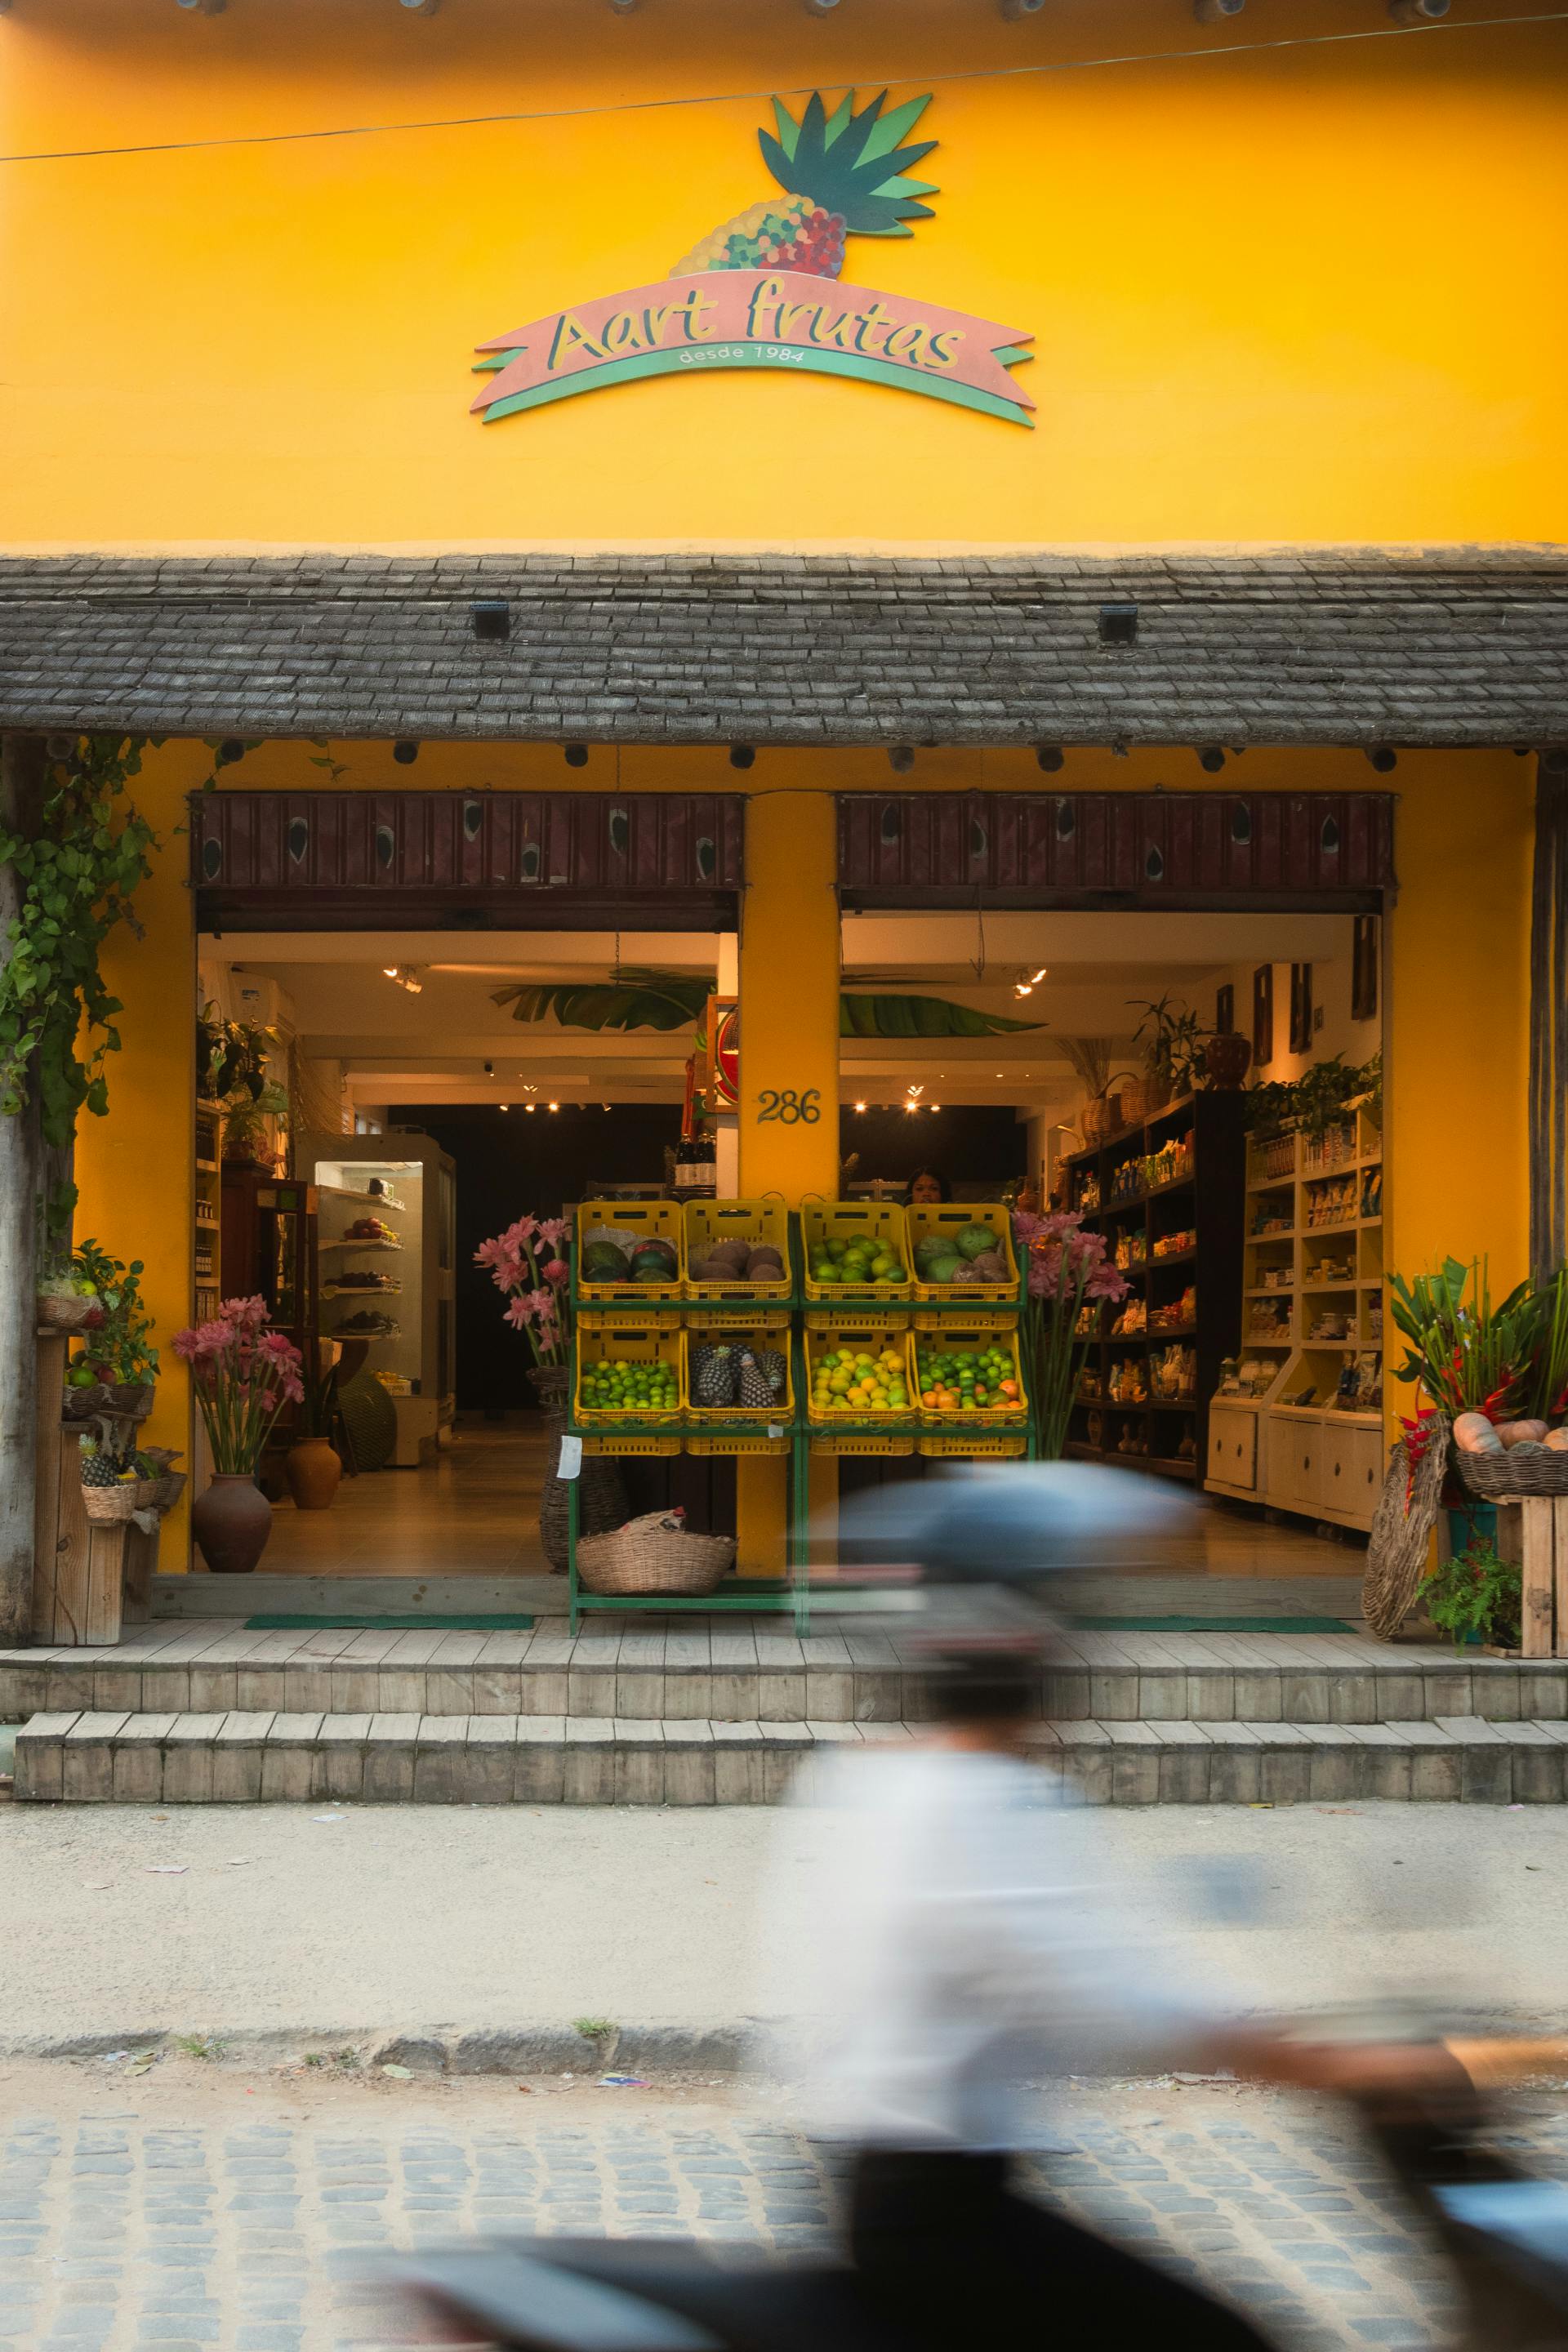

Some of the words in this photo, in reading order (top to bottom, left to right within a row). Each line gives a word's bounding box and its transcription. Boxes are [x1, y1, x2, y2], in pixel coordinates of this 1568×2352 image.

[547, 288, 719, 370] Aart
[746, 276, 966, 368] frutas
[679, 346, 745, 364] desde
[754, 345, 804, 363] 1984
[757, 1089, 821, 1125] 286
